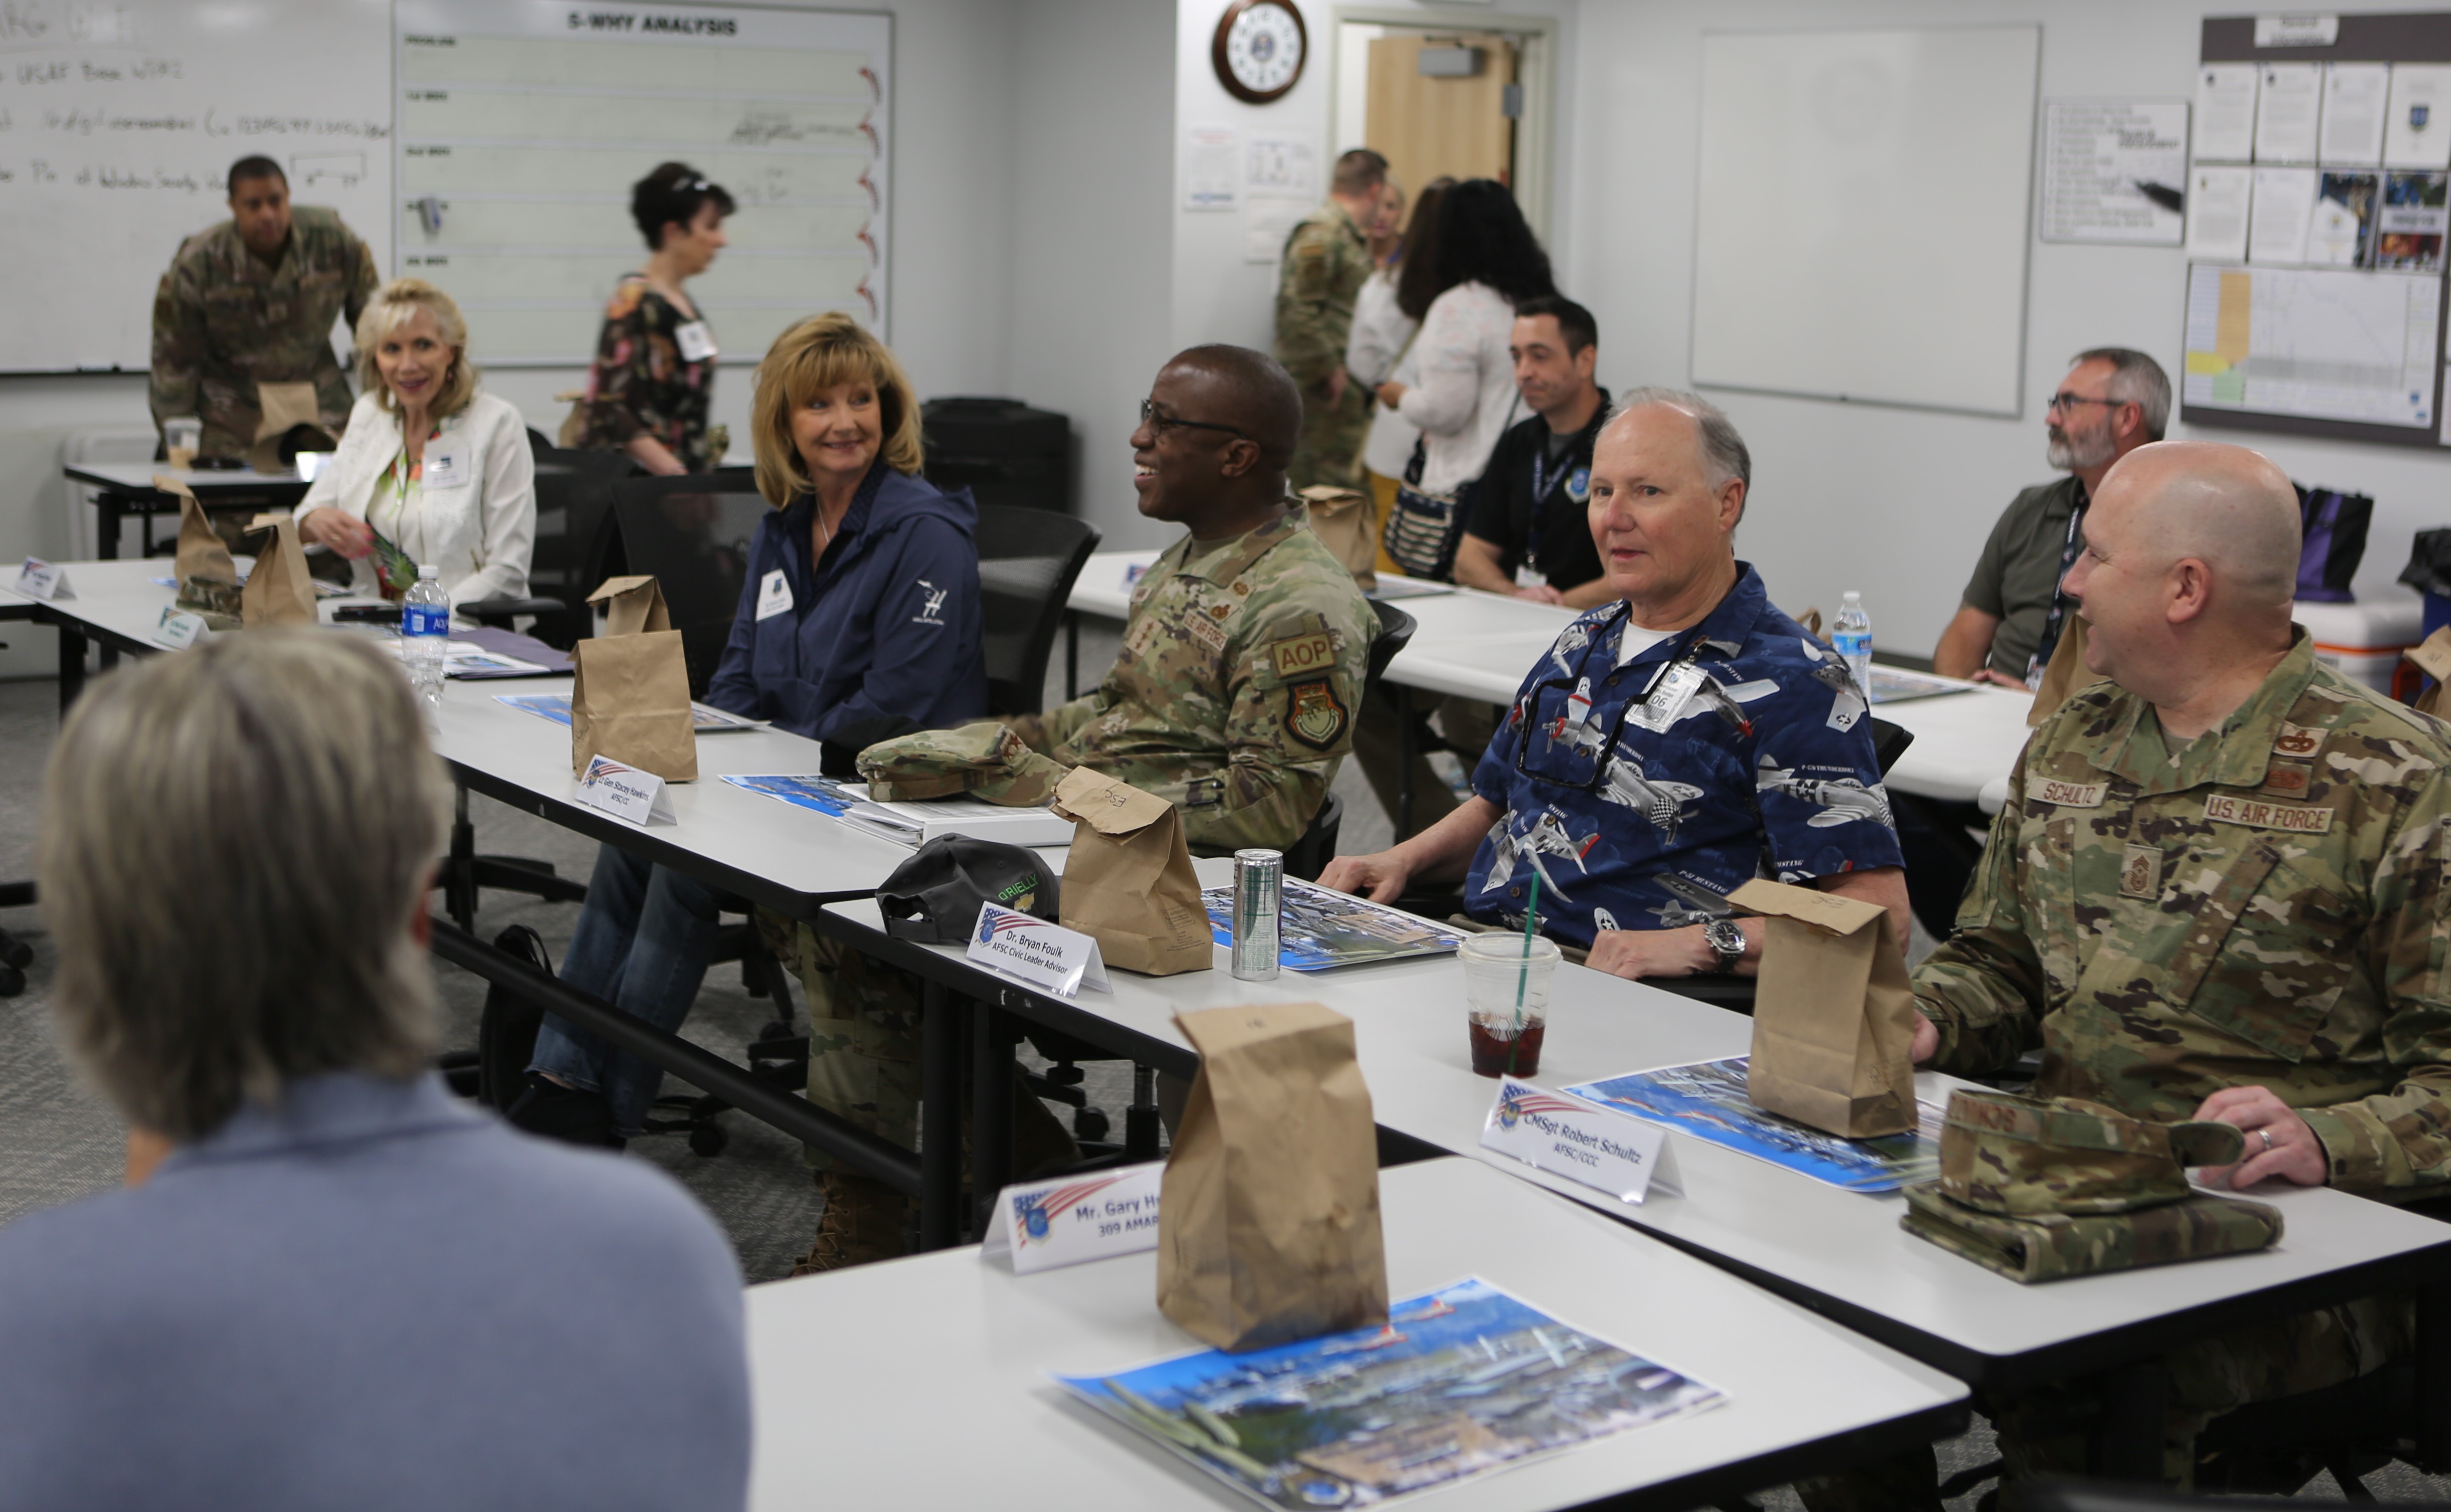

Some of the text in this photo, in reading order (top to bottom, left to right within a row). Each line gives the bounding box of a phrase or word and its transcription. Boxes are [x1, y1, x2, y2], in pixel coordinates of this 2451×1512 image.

[567, 11, 738, 36] 5-WHY ANALYSIS
[1205, 626, 1227, 649] FORCE
[1281, 640, 1327, 670] AOP
[1651, 695, 1668, 707] 06
[604, 778, 614, 789] Gen
[613, 781, 630, 796] Stacey
[2044, 782, 2096, 804] SCHULTZ
[2207, 798, 2327, 830] U.S. AIR FORCE
[998, 873, 1039, 901] O'RIELLY
[1005, 930, 1063, 959] Dr. Bryan Foulk
[992, 942, 1068, 974] AFSC Civic Leader Advisor
[1524, 1112, 1643, 1165] CMSgt Robert Schultz
[1553, 1143, 1600, 1167] AFSC/CCC
[1075, 1206, 1101, 1223] Mr.
[1105, 1199, 1139, 1217] Gary
[1098, 1223, 1122, 1238] 309
